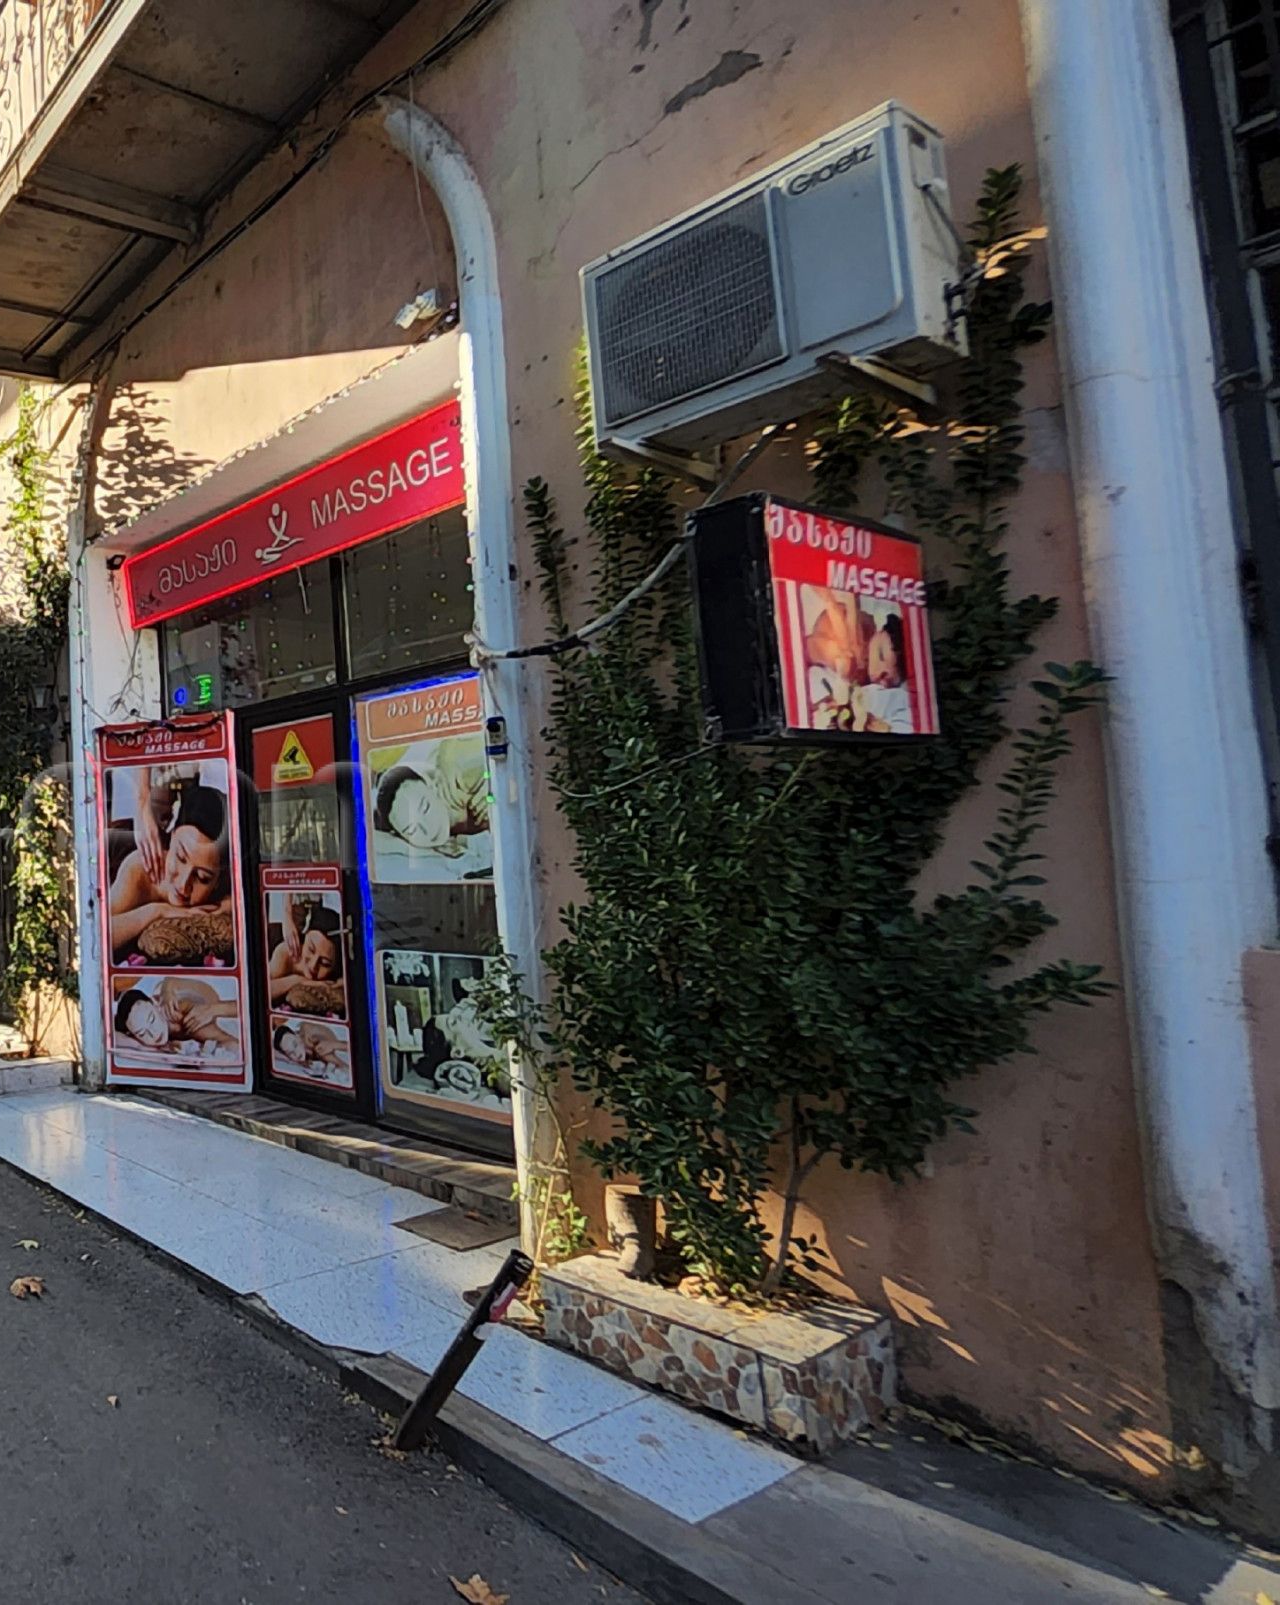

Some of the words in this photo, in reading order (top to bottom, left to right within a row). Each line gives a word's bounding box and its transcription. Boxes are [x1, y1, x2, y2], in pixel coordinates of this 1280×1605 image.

[787, 141, 875, 196] Graetz
[159, 539, 237, 594] მასაჟი
[310, 437, 453, 529] MASSAGE
[827, 559, 927, 606] MASSAGE
[386, 687, 465, 719] მასაჟი
[145, 739, 207, 755] MASSAGE
